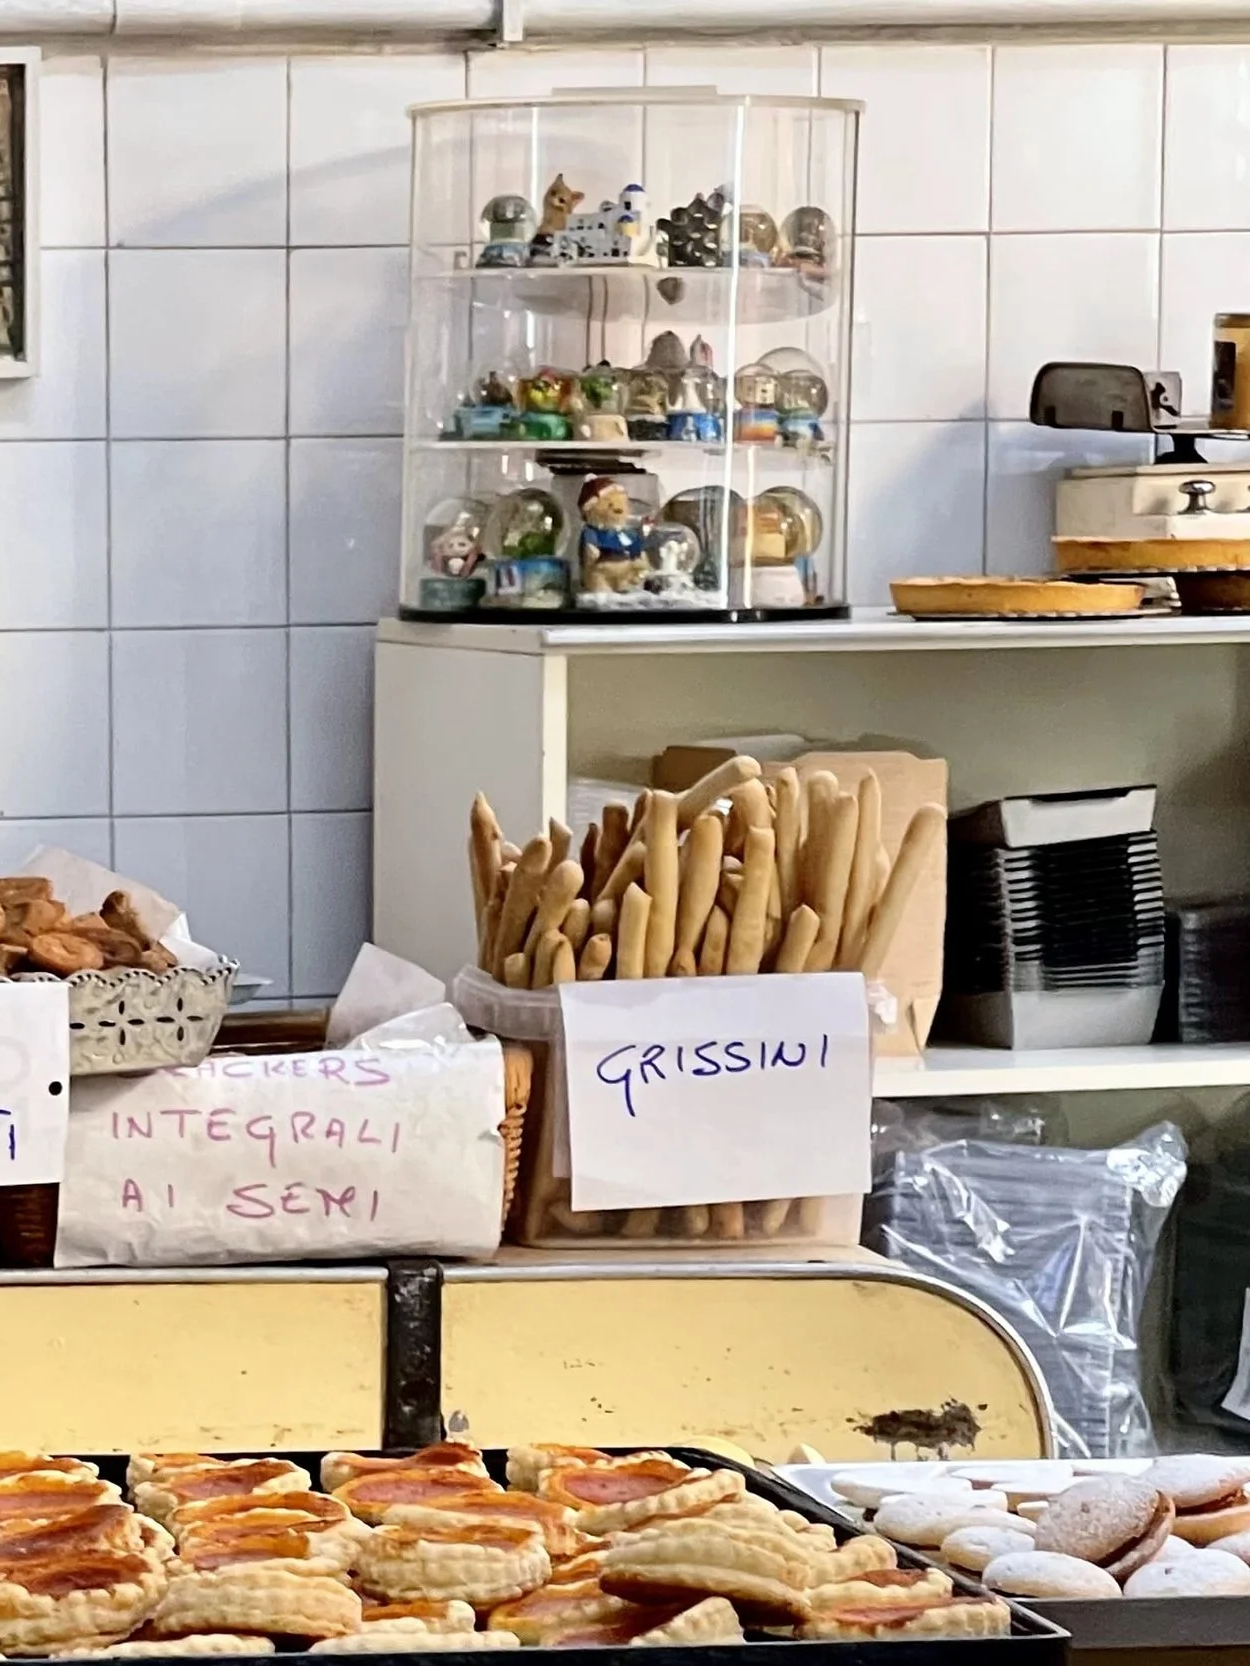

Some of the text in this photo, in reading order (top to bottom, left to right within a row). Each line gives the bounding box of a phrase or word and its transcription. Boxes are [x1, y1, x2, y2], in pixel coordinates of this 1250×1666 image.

[118, 1056, 392, 1087] ACKERS
[596, 1033, 829, 1118] GRISSINI
[111, 1108, 401, 1168] INTEGRALI
[121, 1178, 379, 1222] AI SEMI
